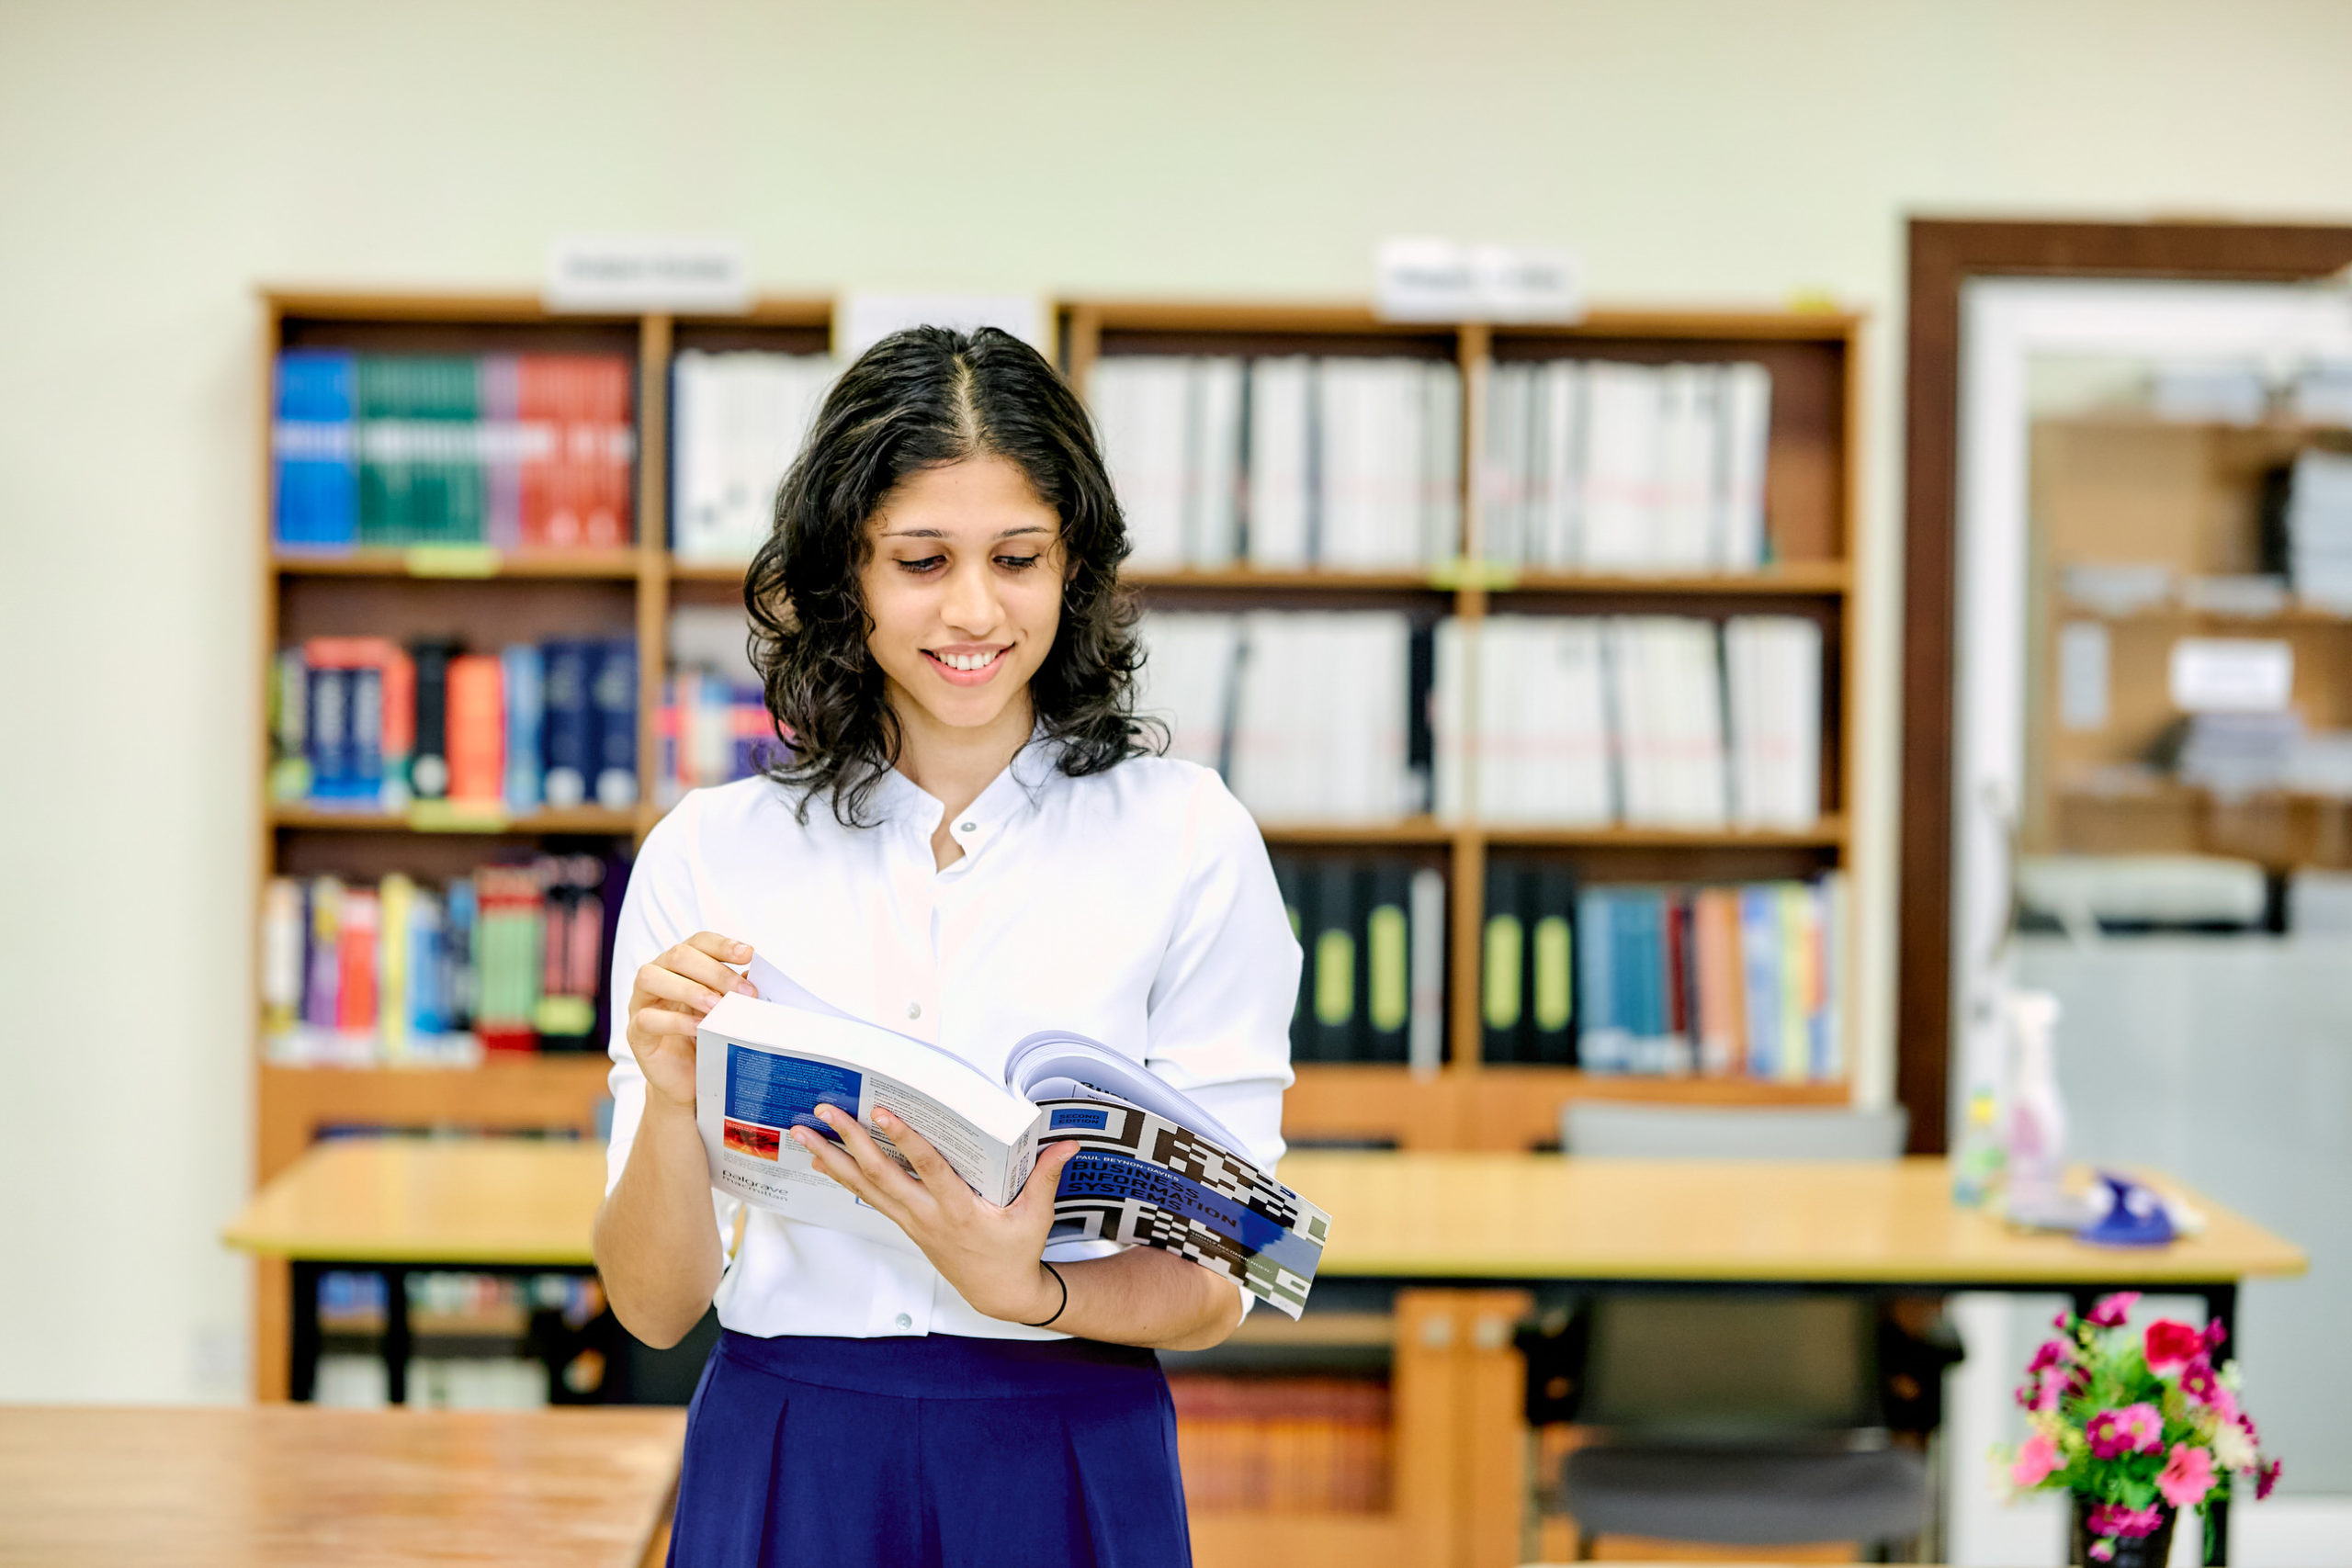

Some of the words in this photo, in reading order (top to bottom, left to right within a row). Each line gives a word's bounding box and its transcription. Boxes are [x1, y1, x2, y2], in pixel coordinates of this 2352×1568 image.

[722, 1169, 789, 1195] palgrave
[1071, 1161, 1199, 1200] BUSINESS
[1103, 1156, 1180, 1182] BEYNON-DAVIES
[1067, 1183, 1182, 1212] SYSTEMS
[1069, 1172, 1237, 1228] INFORMATION
